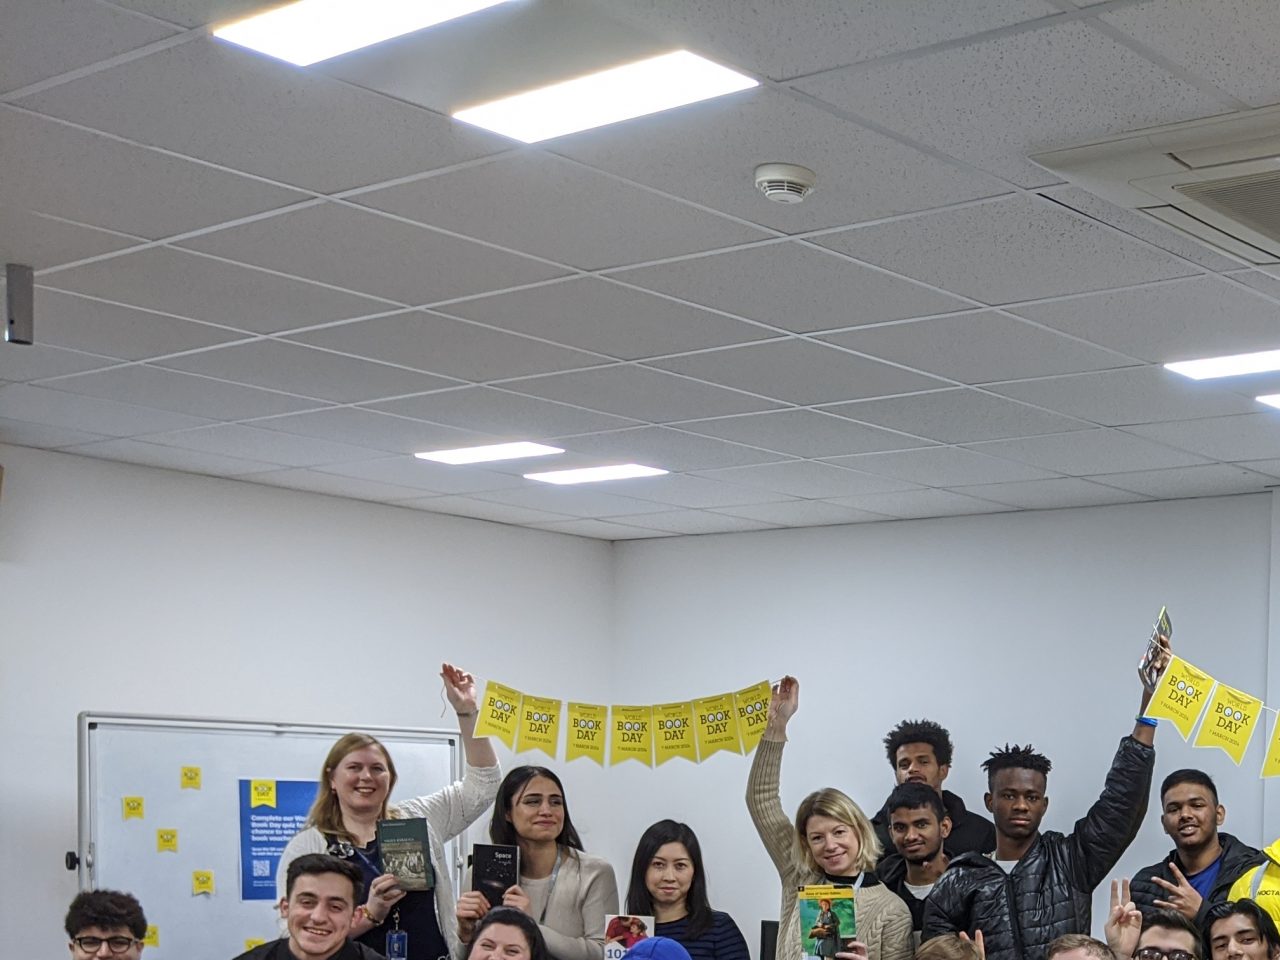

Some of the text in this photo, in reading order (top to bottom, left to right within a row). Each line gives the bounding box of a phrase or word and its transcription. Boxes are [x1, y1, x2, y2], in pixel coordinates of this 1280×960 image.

[1168, 675, 1202, 702] BOOK
[1168, 689, 1193, 709] DAY
[488, 697, 517, 715] BOOK
[738, 698, 768, 717] BOOK
[490, 709, 511, 723] DAY
[526, 711, 555, 724] BOOK
[700, 710, 731, 724] BOOK
[746, 711, 768, 726] DAY
[1215, 702, 1251, 726] BOOK
[529, 723, 550, 734] DAY
[573, 719, 601, 730] BOOK
[617, 721, 647, 731] BOOK
[658, 718, 689, 730] BOOK
[707, 722, 727, 735] DAY
[1216, 717, 1242, 735] DAY
[577, 730, 597, 740] DAY
[622, 733, 643, 743] DAY
[664, 730, 685, 740] DAY
